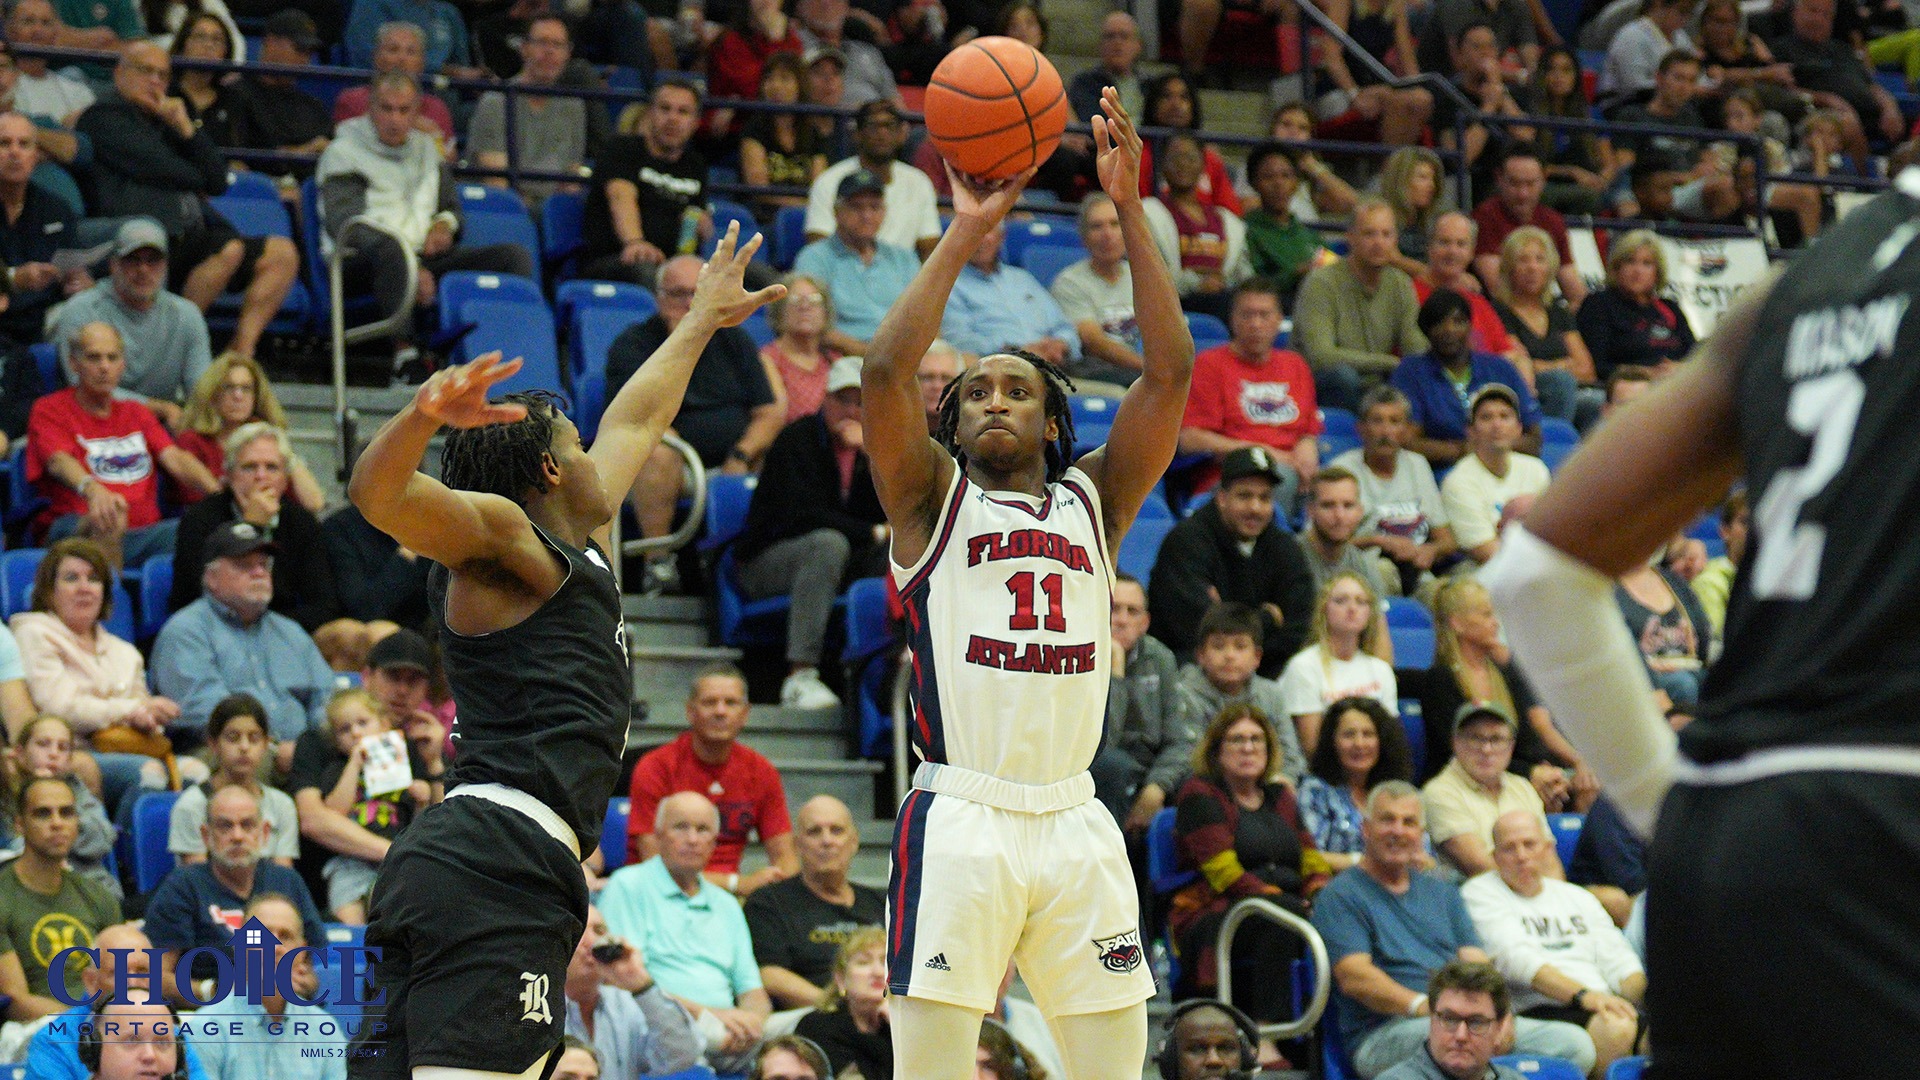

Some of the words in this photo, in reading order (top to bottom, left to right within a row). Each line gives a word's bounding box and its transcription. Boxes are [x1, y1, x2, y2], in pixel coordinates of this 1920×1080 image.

[1752, 367, 1866, 600] 2
[967, 528, 1095, 576] FLORIDA
[1005, 571, 1067, 633] 11
[965, 634, 1096, 675] ATLANTIC
[924, 961, 952, 972] adidas
[1092, 929, 1139, 959] FAU
[519, 971, 554, 1025] R
